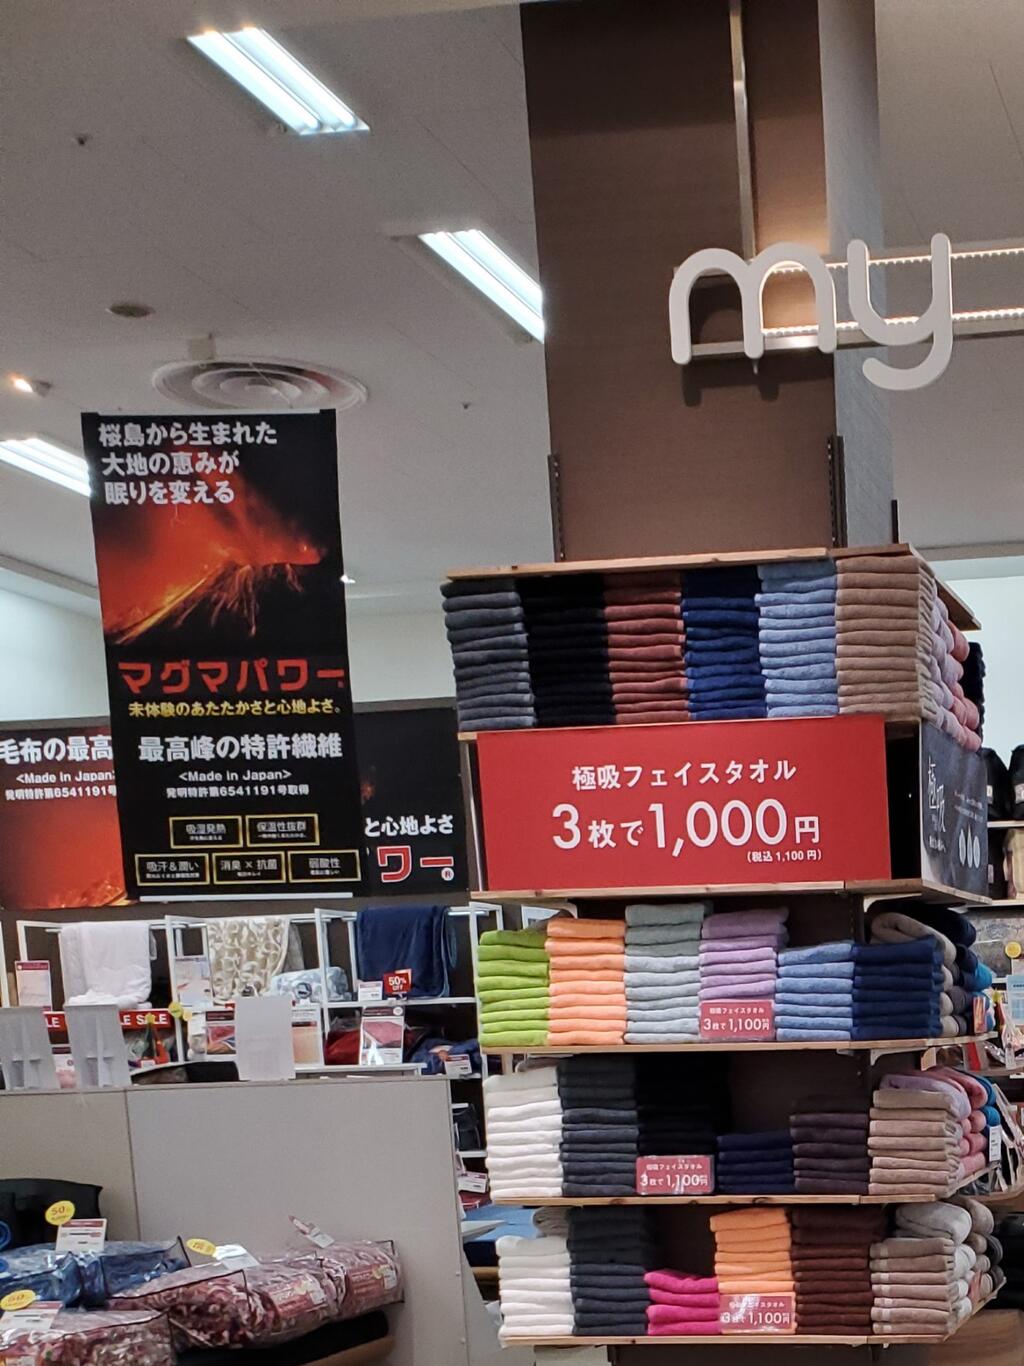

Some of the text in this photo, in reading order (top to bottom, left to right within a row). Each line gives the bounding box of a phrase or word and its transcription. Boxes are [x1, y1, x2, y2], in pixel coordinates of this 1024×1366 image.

[669, 232, 954, 391] my
[98, 421, 278, 448] 桜島から生まれた
[102, 450, 240, 477] 大地の恵みが
[104, 479, 235, 505] 眠りを変える
[118, 658, 345, 694] マグマパワー
[128, 699, 341, 718] 未体験のあたたかさと心地よさ。
[138, 732, 343, 763] 最高峰の特許繊維
[60, 771, 71, 782] in
[227, 770, 238, 781] in
[572, 759, 797, 791] 極吸フェイスタオル
[364, 814, 454, 837] と心地よさ
[551, 798, 821, 858] 3枚で1,000円
[45, 1017, 60, 1028] LE
